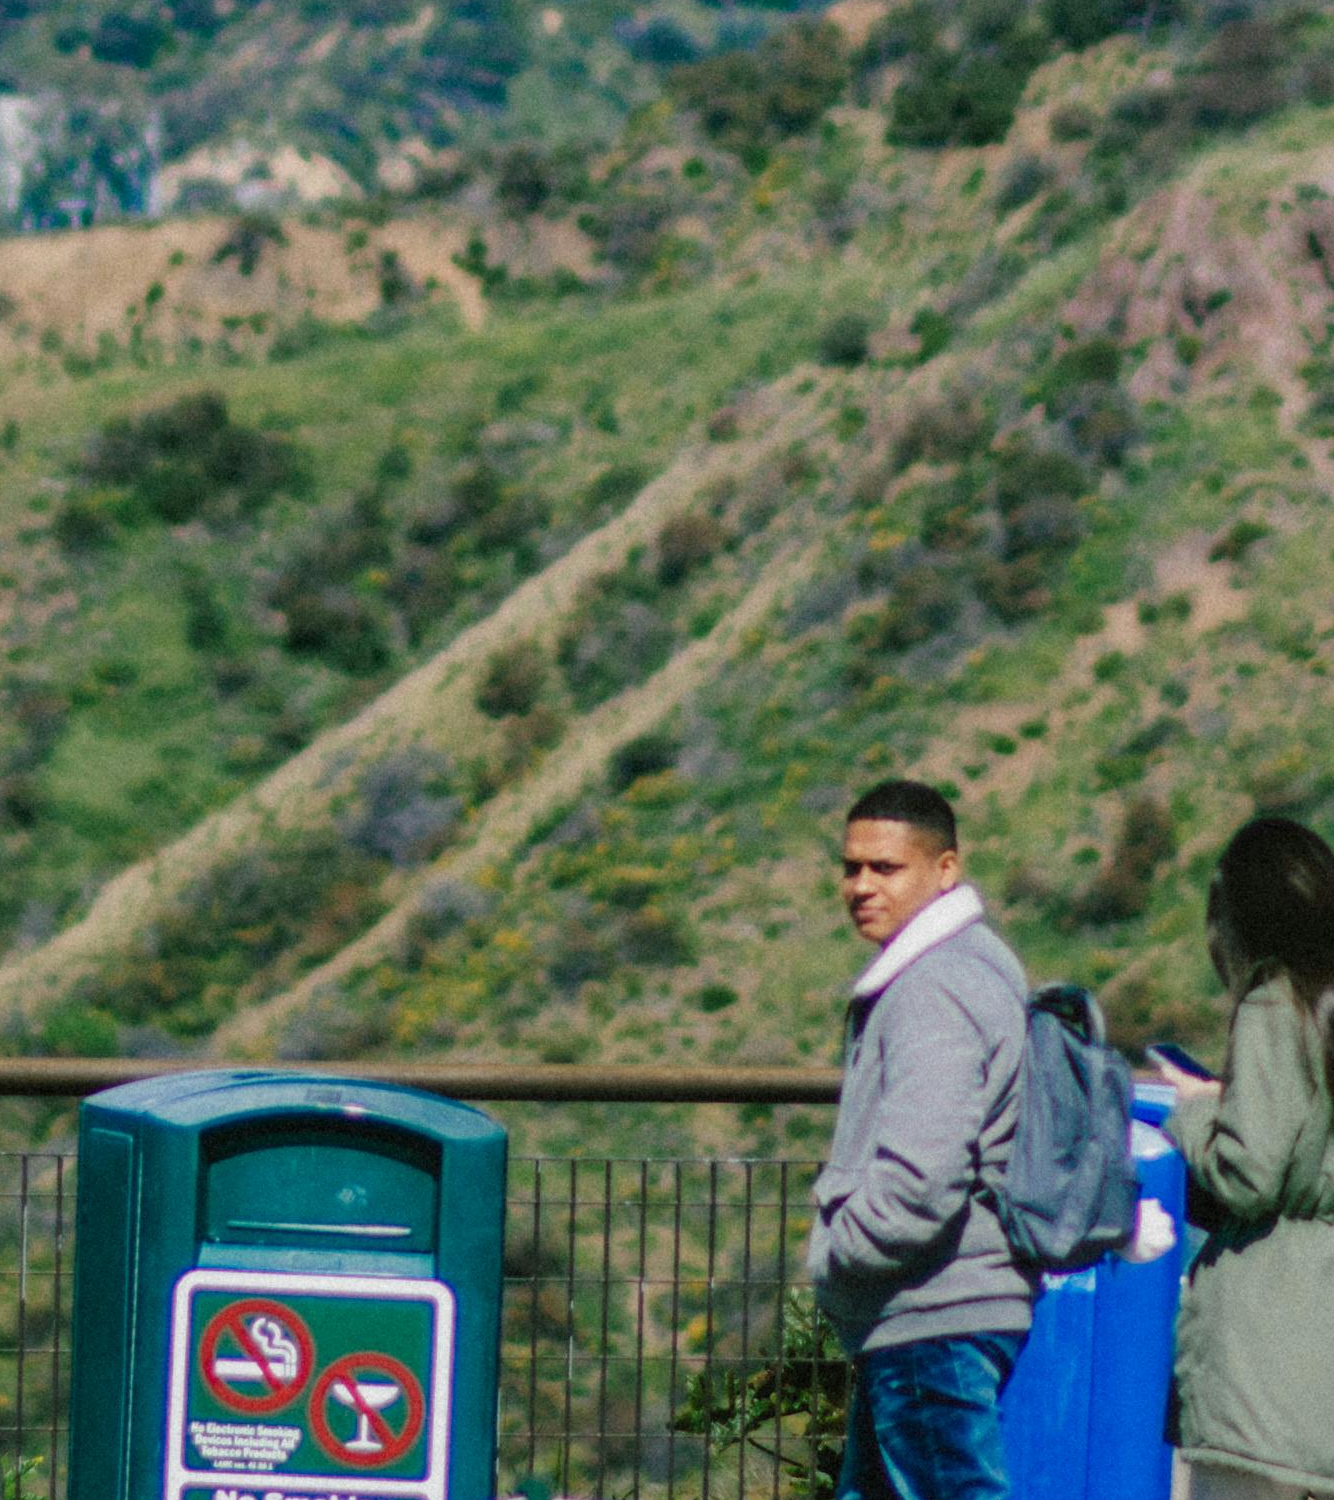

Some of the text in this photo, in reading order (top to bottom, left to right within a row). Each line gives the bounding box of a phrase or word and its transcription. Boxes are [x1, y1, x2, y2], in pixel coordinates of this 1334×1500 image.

[190, 1421, 301, 1441] No Electronic Smoking
[201, 1445, 242, 1458] Tobacco
